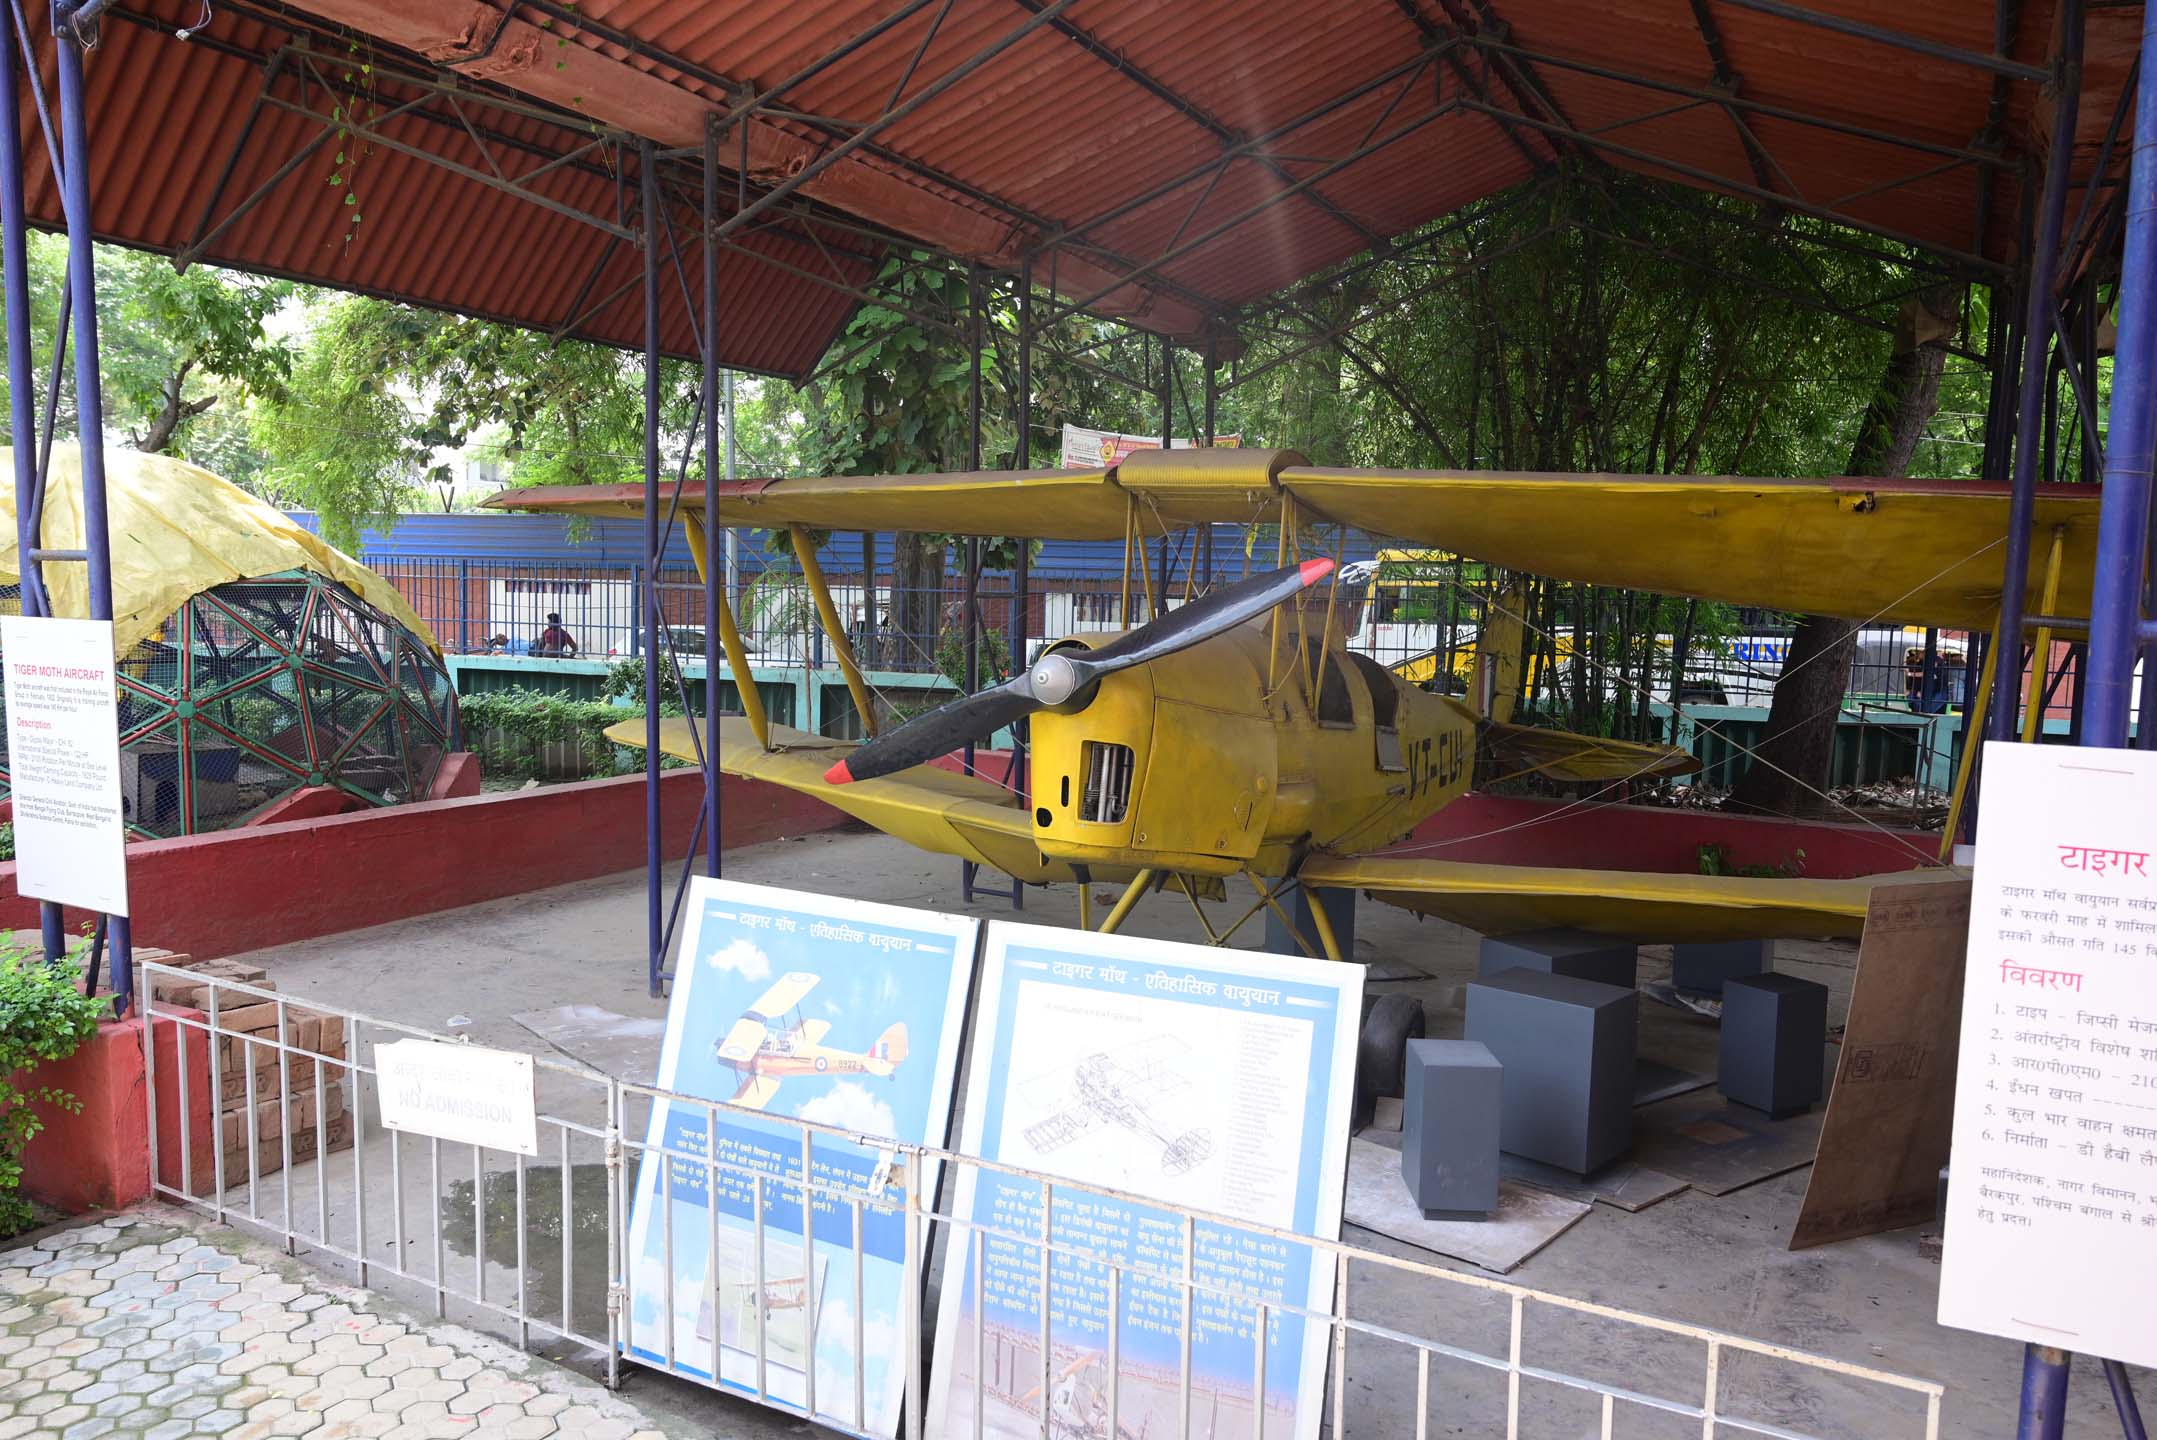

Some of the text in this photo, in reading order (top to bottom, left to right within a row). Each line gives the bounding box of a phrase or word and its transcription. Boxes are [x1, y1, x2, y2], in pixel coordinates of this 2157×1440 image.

[14, 663, 105, 681] TIGER MOTH AIRCRAFT
[2057, 845, 2151, 878] टाइगर
[2000, 885, 2036, 899] टाइगर
[2072, 893, 2120, 910] वायुयान
[739, 912, 772, 929] टाइगर
[868, 932, 913, 952] वायुयान
[2019, 909, 2059, 924] फरवरी
[2066, 914, 2089, 928] माह
[2114, 943, 2138, 956] 145
[1052, 961, 1095, 981] टाइगर
[1098, 966, 1129, 985] मॉथ
[1223, 984, 1281, 1007] वायुयान
[1999, 958, 2084, 993] विवरण
[2015, 1004, 2049, 1021] टाइप
[424, 1093, 513, 1125] ADMISSION
